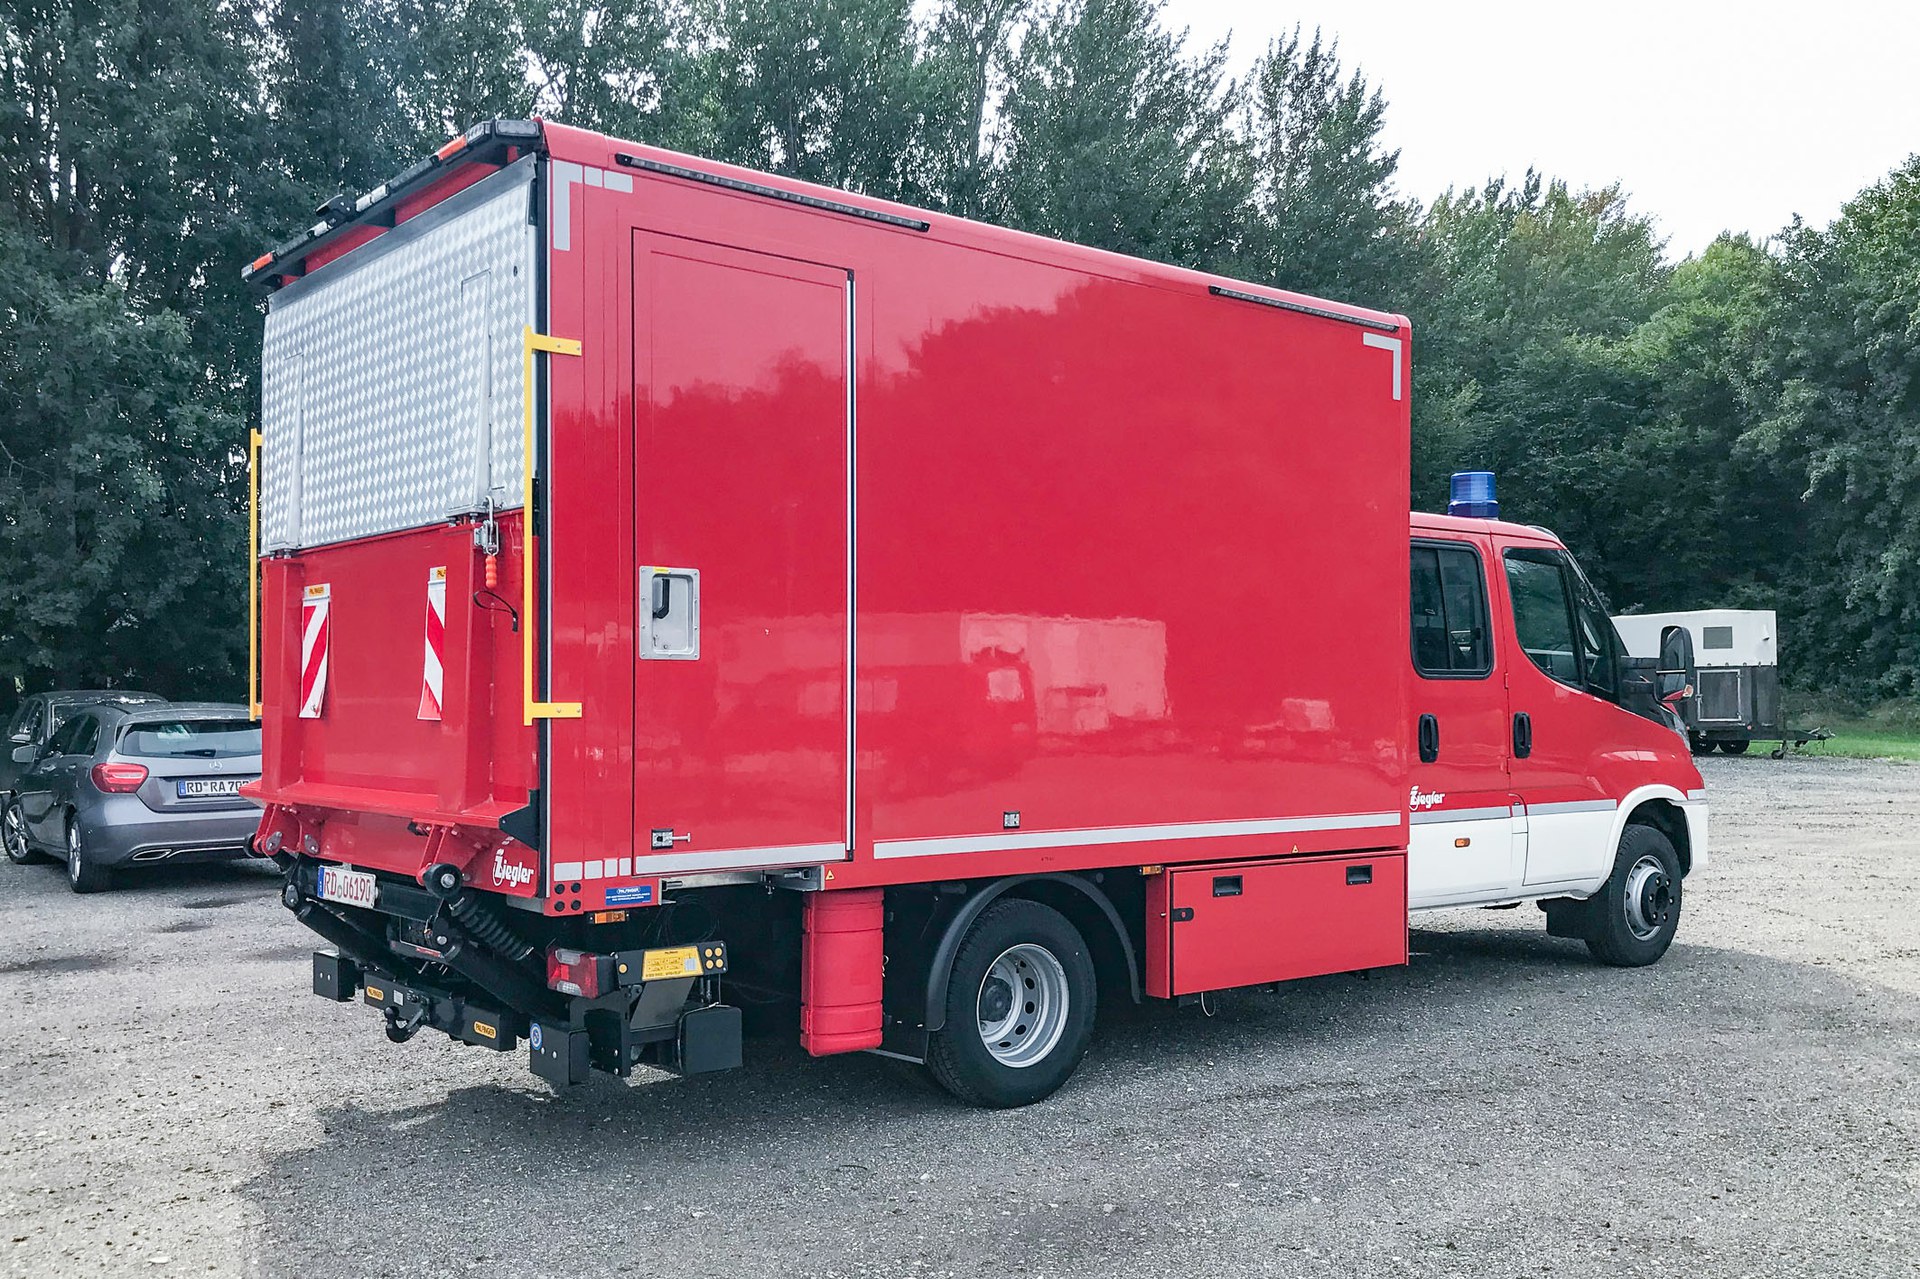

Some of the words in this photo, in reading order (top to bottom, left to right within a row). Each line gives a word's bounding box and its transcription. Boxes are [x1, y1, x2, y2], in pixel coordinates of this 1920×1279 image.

[187, 782, 203, 793] RD
[210, 781, 226, 792] RA
[1409, 785, 1445, 811] Ziegler
[493, 848, 534, 888] Ziegler
[324, 871, 337, 896] RD
[343, 875, 371, 903] 06190
